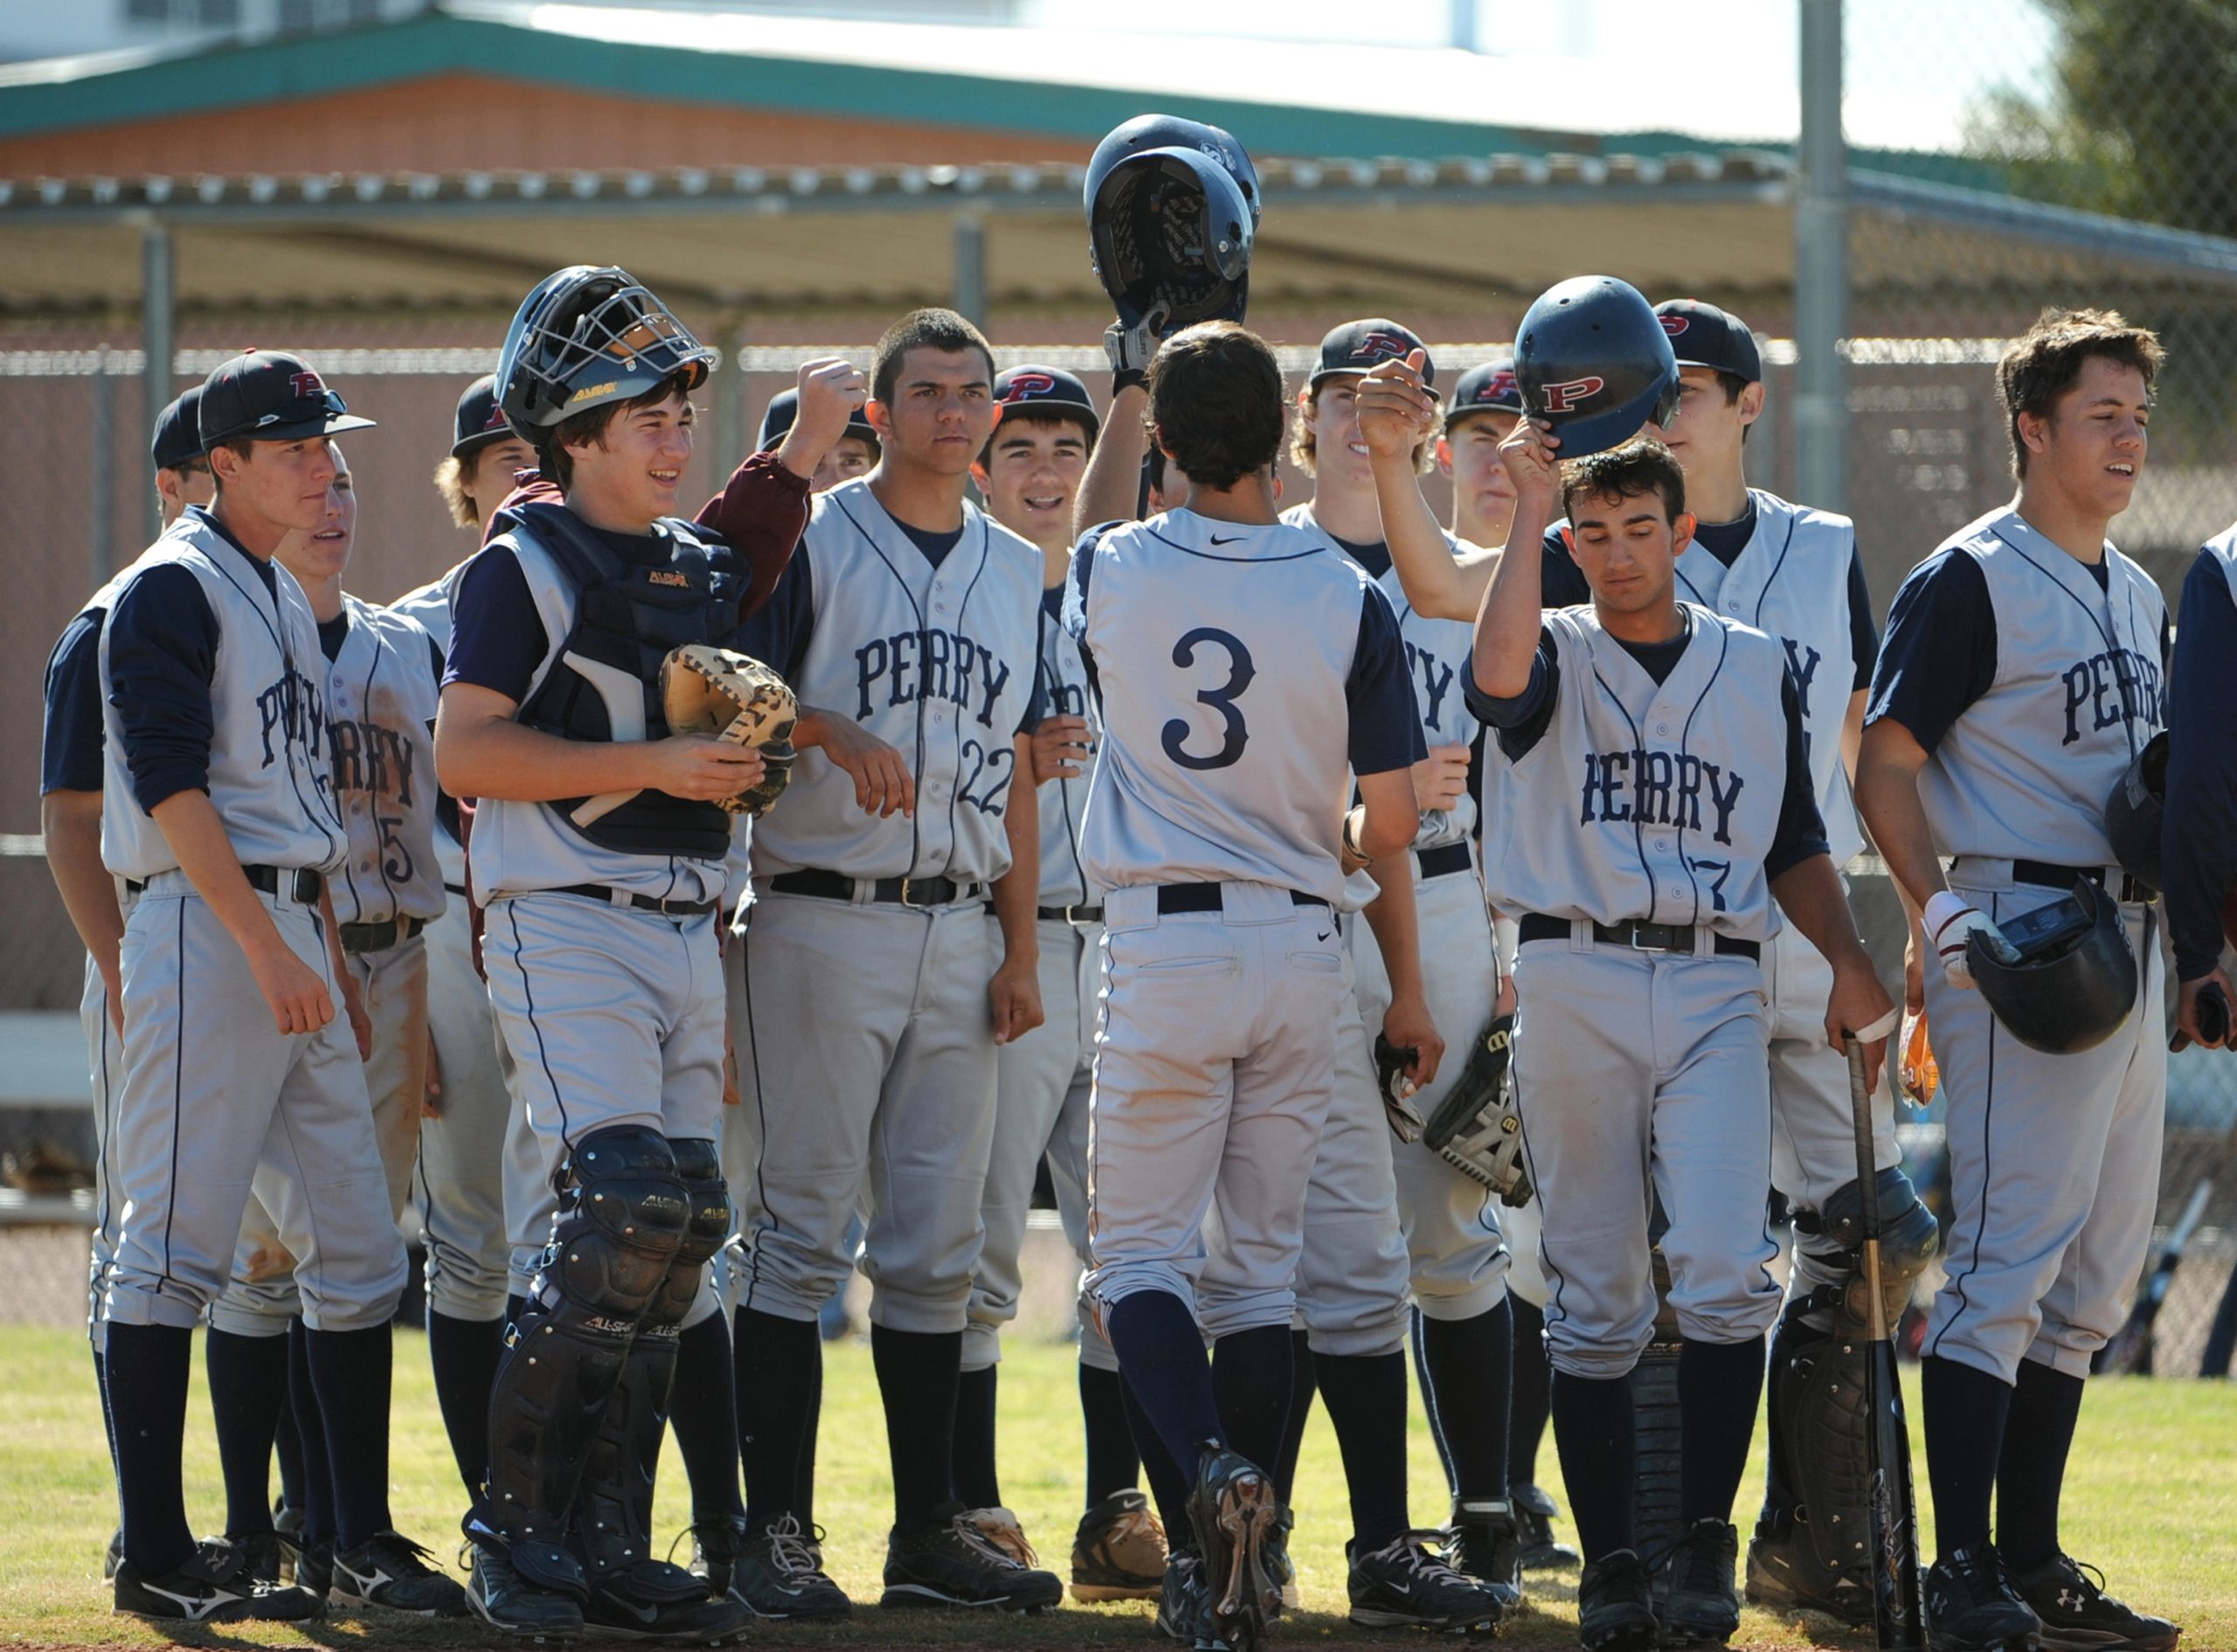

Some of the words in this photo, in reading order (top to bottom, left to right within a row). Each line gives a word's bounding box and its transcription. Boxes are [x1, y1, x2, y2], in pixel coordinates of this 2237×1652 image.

[1349, 332, 1407, 359] P
[1001, 374, 1055, 402] P
[1541, 376, 1604, 413] P
[855, 628, 1009, 729] PERRY
[1160, 626, 1257, 771] 3
[329, 720, 413, 808] RRY
[958, 739, 1015, 817] 22
[1581, 749, 1744, 847] PERRY
[379, 818, 413, 883] 5
[1686, 856, 1731, 911] 7
